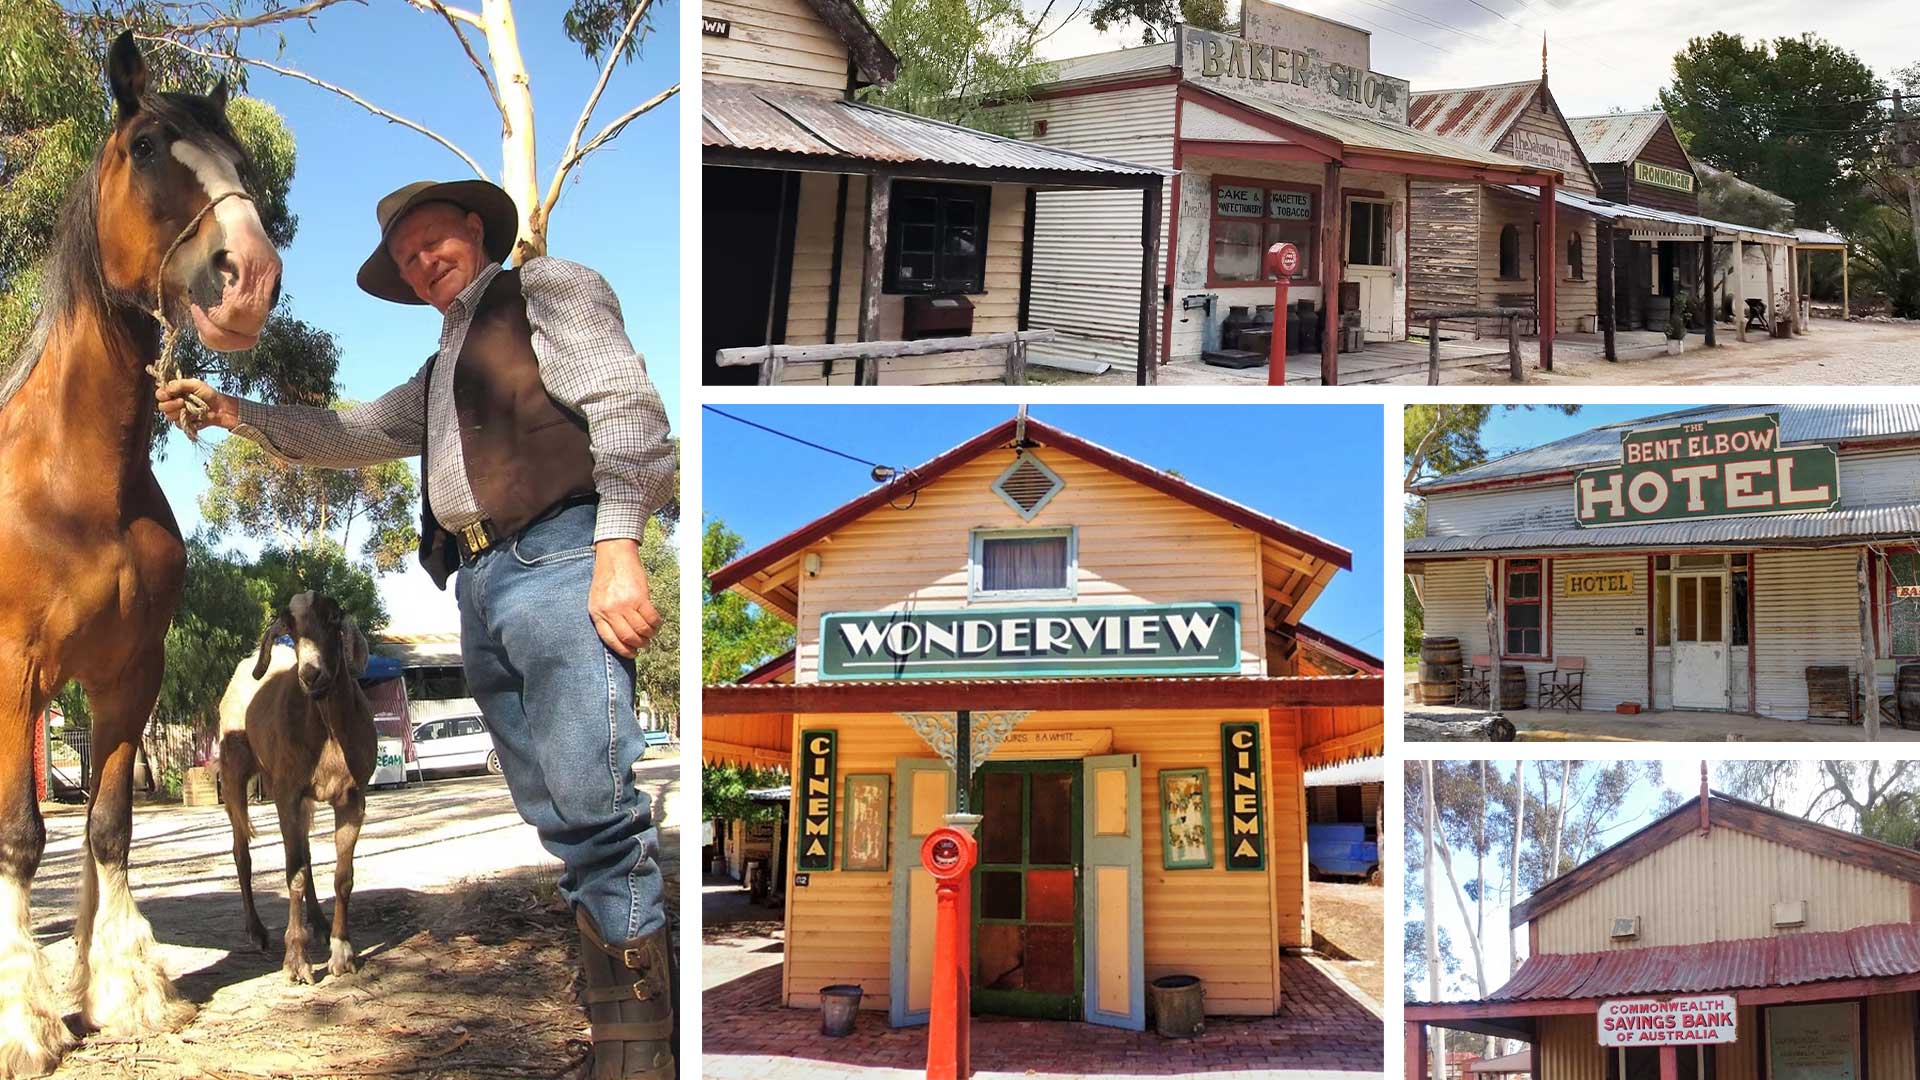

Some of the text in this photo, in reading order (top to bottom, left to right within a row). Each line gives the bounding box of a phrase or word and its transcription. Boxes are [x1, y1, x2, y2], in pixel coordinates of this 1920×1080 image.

[702, 20, 726, 33] WN
[1202, 39, 1397, 114] BAKER SHOP
[1639, 164, 1690, 190] IRONMONGER
[1217, 189, 1248, 200] CAKE
[1277, 206, 1310, 218] TOBACCO
[1683, 424, 1704, 433] THE
[1627, 428, 1775, 464] BENT ELBOW
[1580, 457, 1830, 520] HOTEL
[1571, 575, 1628, 592] HOTEL
[838, 611, 1221, 658] WONDERVIEW
[806, 737, 829, 856] CINEMA
[1232, 731, 1259, 857] CINEMA
[1610, 1000, 1724, 1015] COMMONWEALTH
[1603, 1012, 1733, 1031] SAVINGS BANK
[1616, 1029, 1719, 1042] OF AUSTRALIA
